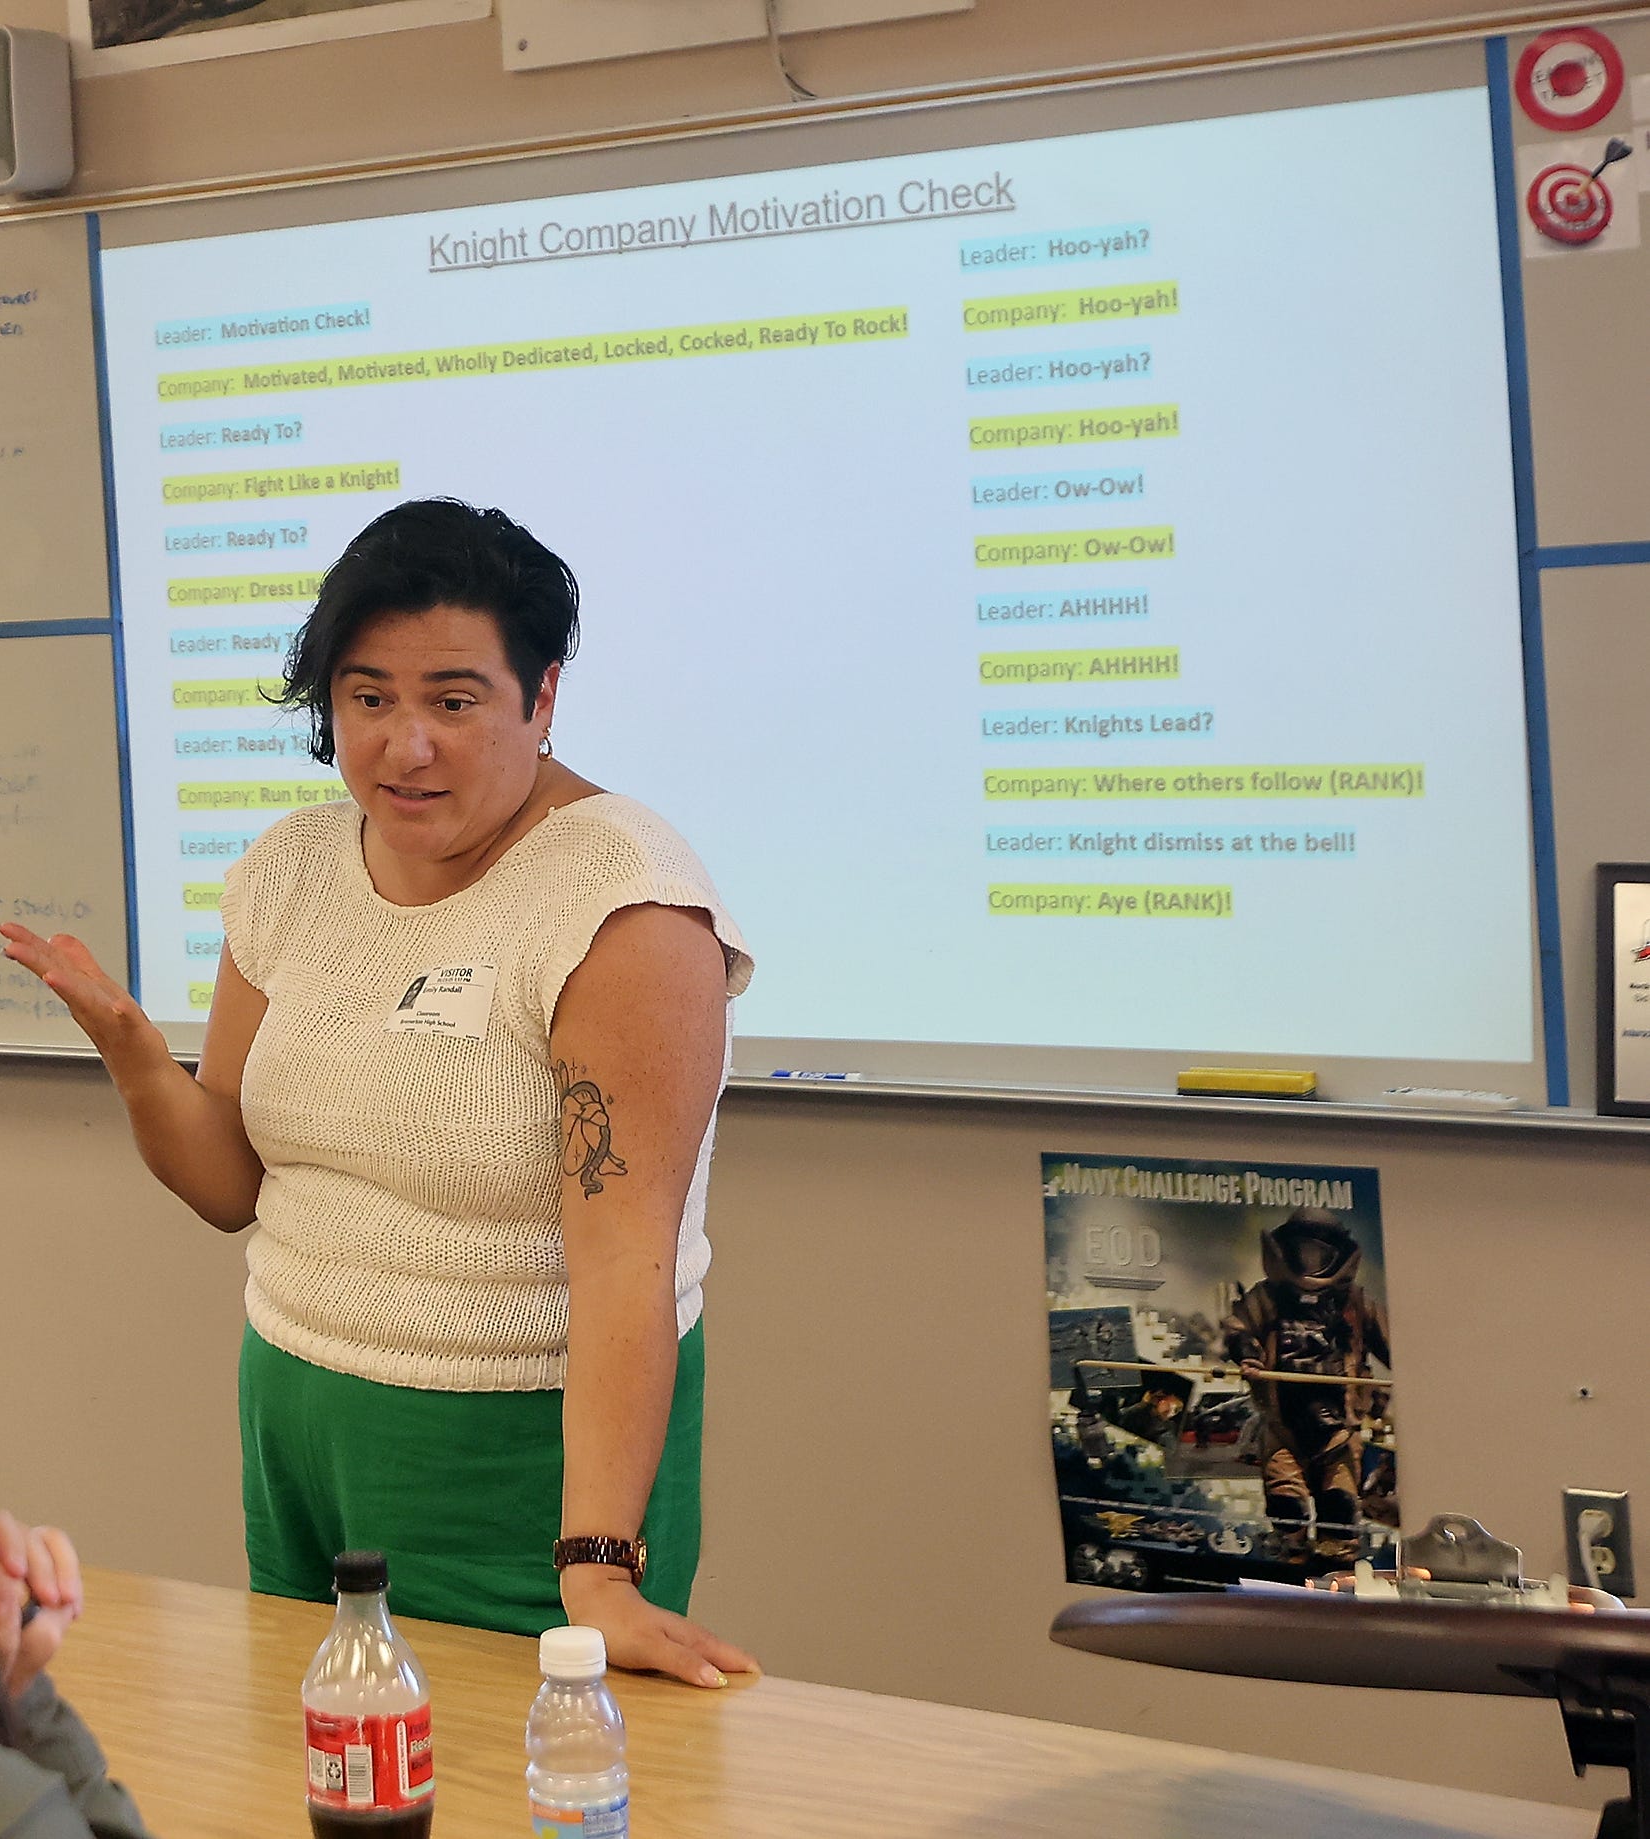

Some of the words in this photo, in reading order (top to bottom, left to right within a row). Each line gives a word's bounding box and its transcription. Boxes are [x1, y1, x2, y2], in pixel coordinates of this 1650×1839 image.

[430, 226, 528, 268] Knight
[540, 212, 696, 255] Company
[709, 190, 886, 236] Motivation
[899, 171, 1015, 216] Check
[960, 244, 1037, 267] Leader:
[1049, 229, 1149, 258] Hoo-yah?
[964, 303, 1066, 326] Company:
[1079, 288, 1178, 316] Hoo-yah!
[156, 325, 211, 346] Leader:
[221, 314, 309, 339] Motivation
[315, 307, 370, 331] Check!
[158, 377, 235, 398] Company:
[244, 367, 332, 389] Motivated,
[338, 357, 431, 382] Motivated,
[435, 350, 497, 374] Wholly
[503, 344, 598, 368] Dedicated,
[605, 335, 673, 360] Locked,
[681, 329, 753, 353] Cocked,
[759, 323, 817, 347] Ready
[824, 320, 847, 340] To
[853, 313, 908, 336] Rock!
[967, 364, 1043, 386] Leader:
[1049, 352, 1151, 380] Hoo-yah?
[160, 429, 217, 449] Leader:
[222, 423, 271, 444] Ready
[274, 420, 303, 440] To?
[969, 424, 1072, 446] Company:
[1079, 411, 1178, 438] Hoo-yah!
[163, 481, 239, 502] Company:
[245, 475, 284, 498] Fight
[289, 472, 320, 492] Like
[326, 476, 336, 490] a
[340, 467, 400, 490] Knight!
[973, 482, 1048, 504] Leader:
[1055, 474, 1144, 499] Ow-Ow!
[165, 533, 221, 552] Leader:
[227, 527, 276, 549] Ready
[280, 525, 308, 544] To?
[975, 543, 1078, 565] Company:
[1085, 533, 1174, 557] Ow-Ow!
[168, 584, 244, 605] Company:
[250, 581, 293, 598] Dress
[298, 577, 322, 596] Lik
[978, 601, 1053, 621] Leader:
[1060, 594, 1149, 617] AHHHH!
[170, 635, 226, 654] Leader:
[232, 632, 281, 652] Ready
[980, 661, 1083, 682] Company:
[1089, 654, 1179, 677] AHHHH!
[173, 686, 250, 705] Company:
[982, 716, 1057, 736] Leader:
[1065, 713, 1143, 738] Knights
[1150, 712, 1213, 734] Lead?
[175, 737, 231, 755] Leader:
[237, 735, 286, 755] Ready
[178, 787, 254, 807] Company:
[260, 786, 292, 803] Run
[297, 784, 320, 802] for
[325, 784, 350, 800] the
[984, 774, 1087, 797] Company:
[1094, 773, 1167, 792] Where
[1173, 771, 1246, 791] others
[1250, 770, 1324, 792] follow
[1330, 769, 1424, 797] (RANK)!
[180, 838, 237, 856] Leader:
[986, 833, 1063, 852] Leader:
[1069, 832, 1138, 856] Knight
[1144, 832, 1225, 852] dismiss
[1231, 834, 1254, 852] at
[1261, 833, 1297, 852] the
[1305, 833, 1355, 852] bell!
[988, 890, 1091, 912] Company:
[1097, 890, 1136, 911] Aye
[1145, 889, 1231, 914] (RANK)!
[440, 968, 473, 977] VISITOR
[1063, 1162, 1120, 1197] NAVY
[1124, 1165, 1242, 1205] CHALLENGE
[1244, 1171, 1354, 1210] PROGRAM
[1085, 1222, 1163, 1268] EOD
